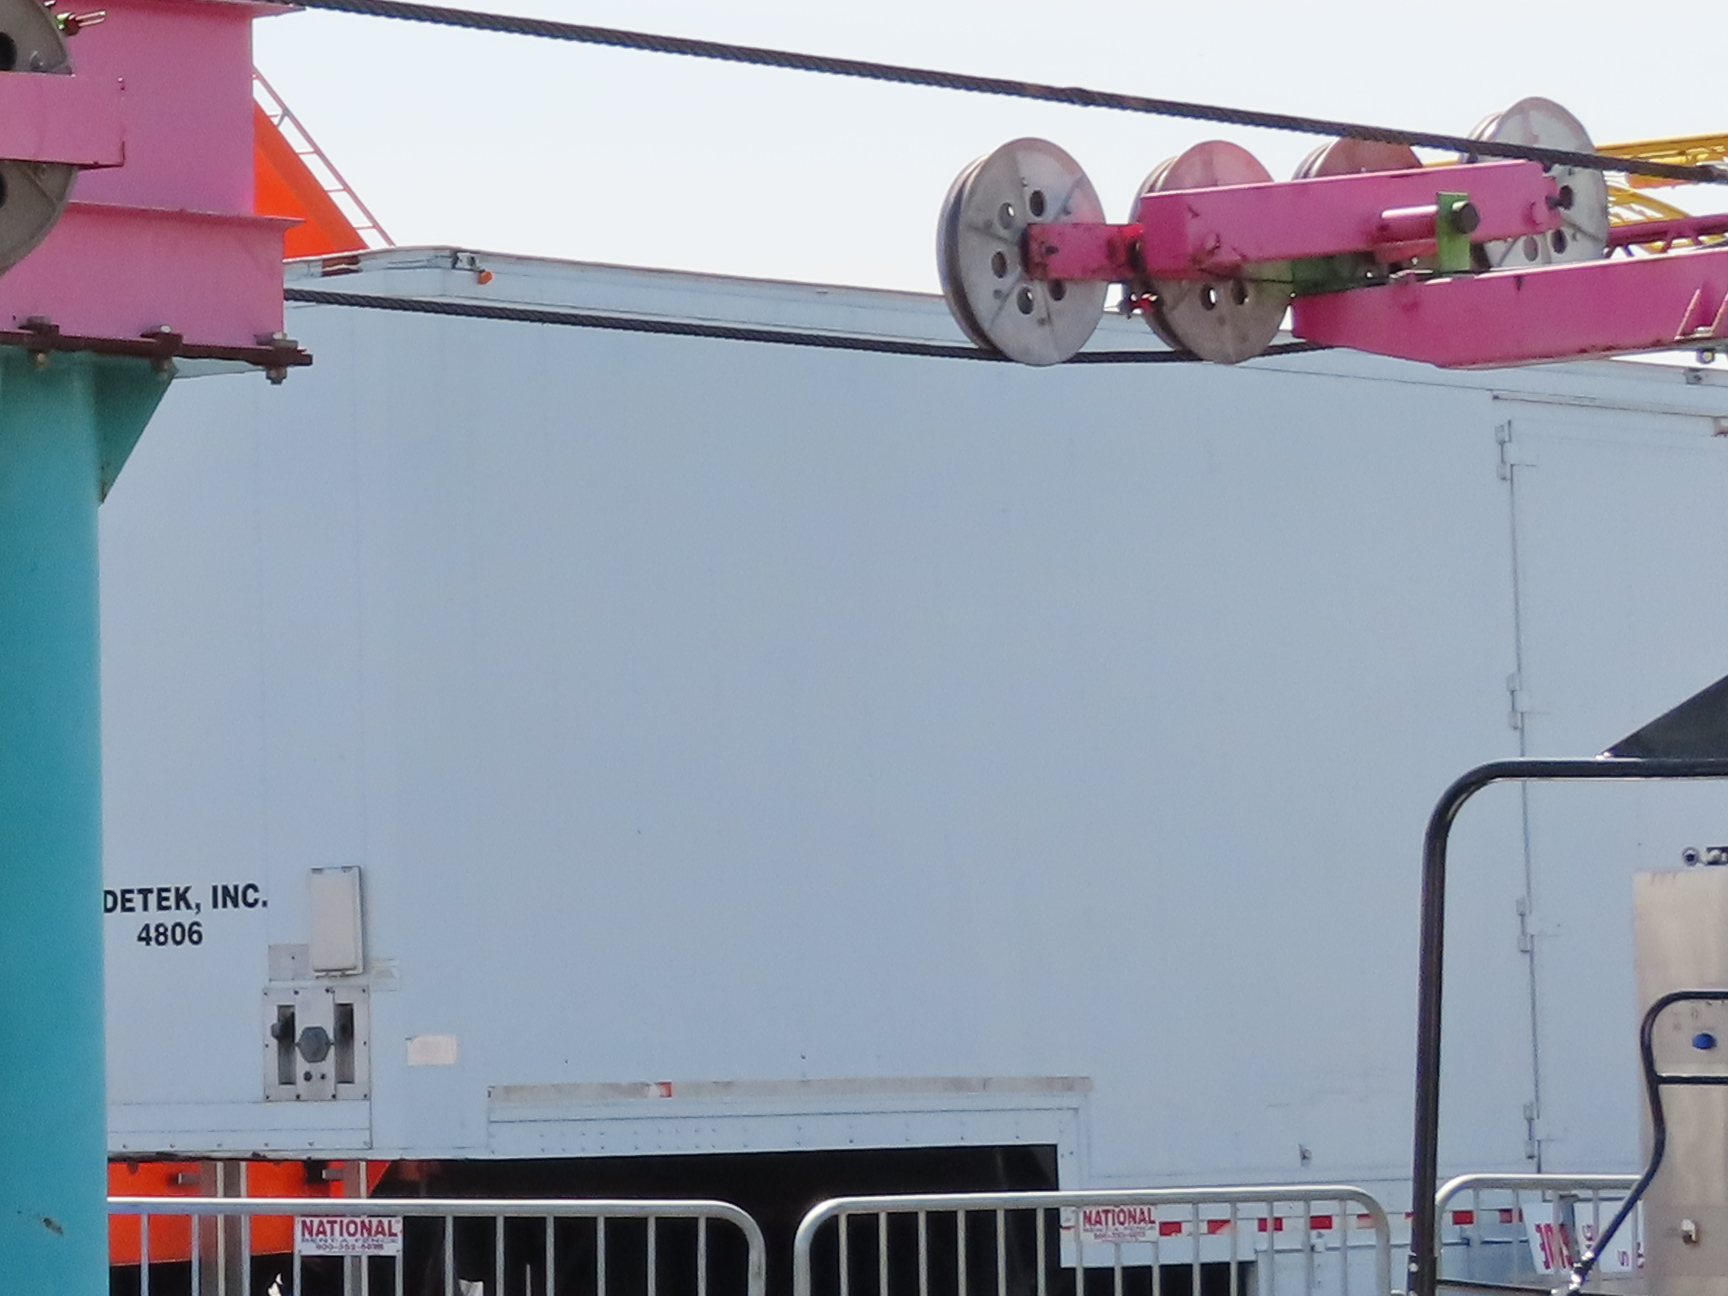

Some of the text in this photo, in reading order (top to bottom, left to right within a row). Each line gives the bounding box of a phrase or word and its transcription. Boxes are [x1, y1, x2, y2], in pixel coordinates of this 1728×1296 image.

[212, 883, 268, 909] INC.
[137, 921, 203, 946] 4806
[1083, 1207, 1156, 1226] NATIONAL
[301, 1219, 397, 1237] NATIONAL
